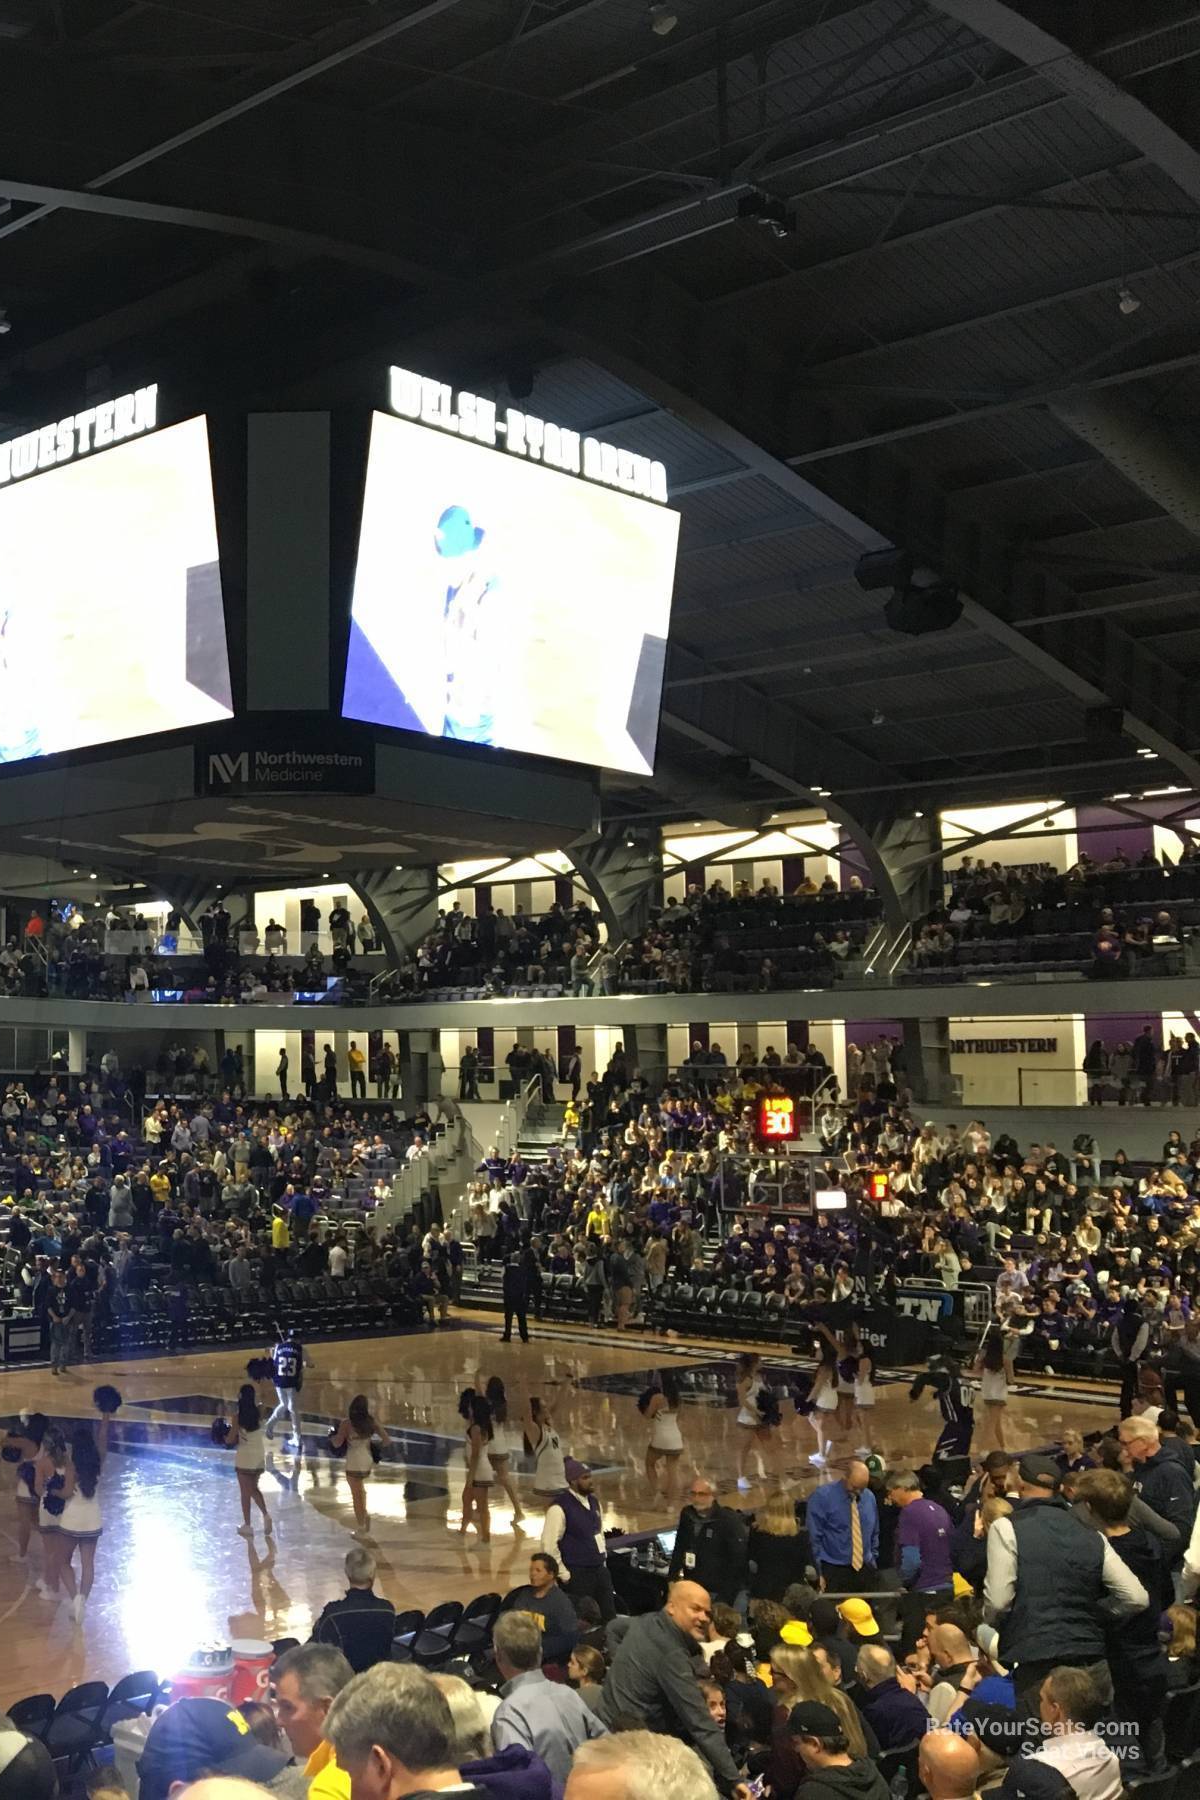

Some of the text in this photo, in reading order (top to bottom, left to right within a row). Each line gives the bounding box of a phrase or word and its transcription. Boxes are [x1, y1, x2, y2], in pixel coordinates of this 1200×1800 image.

[390, 364, 668, 504] WELSH-RYAN ARENA
[255, 751, 362, 767] Northwestern
[255, 768, 322, 782] Medicine
[950, 1037, 1058, 1054] ORTHWESTERN
[766, 1111, 791, 1135] 30
[278, 1356, 297, 1377] 23
